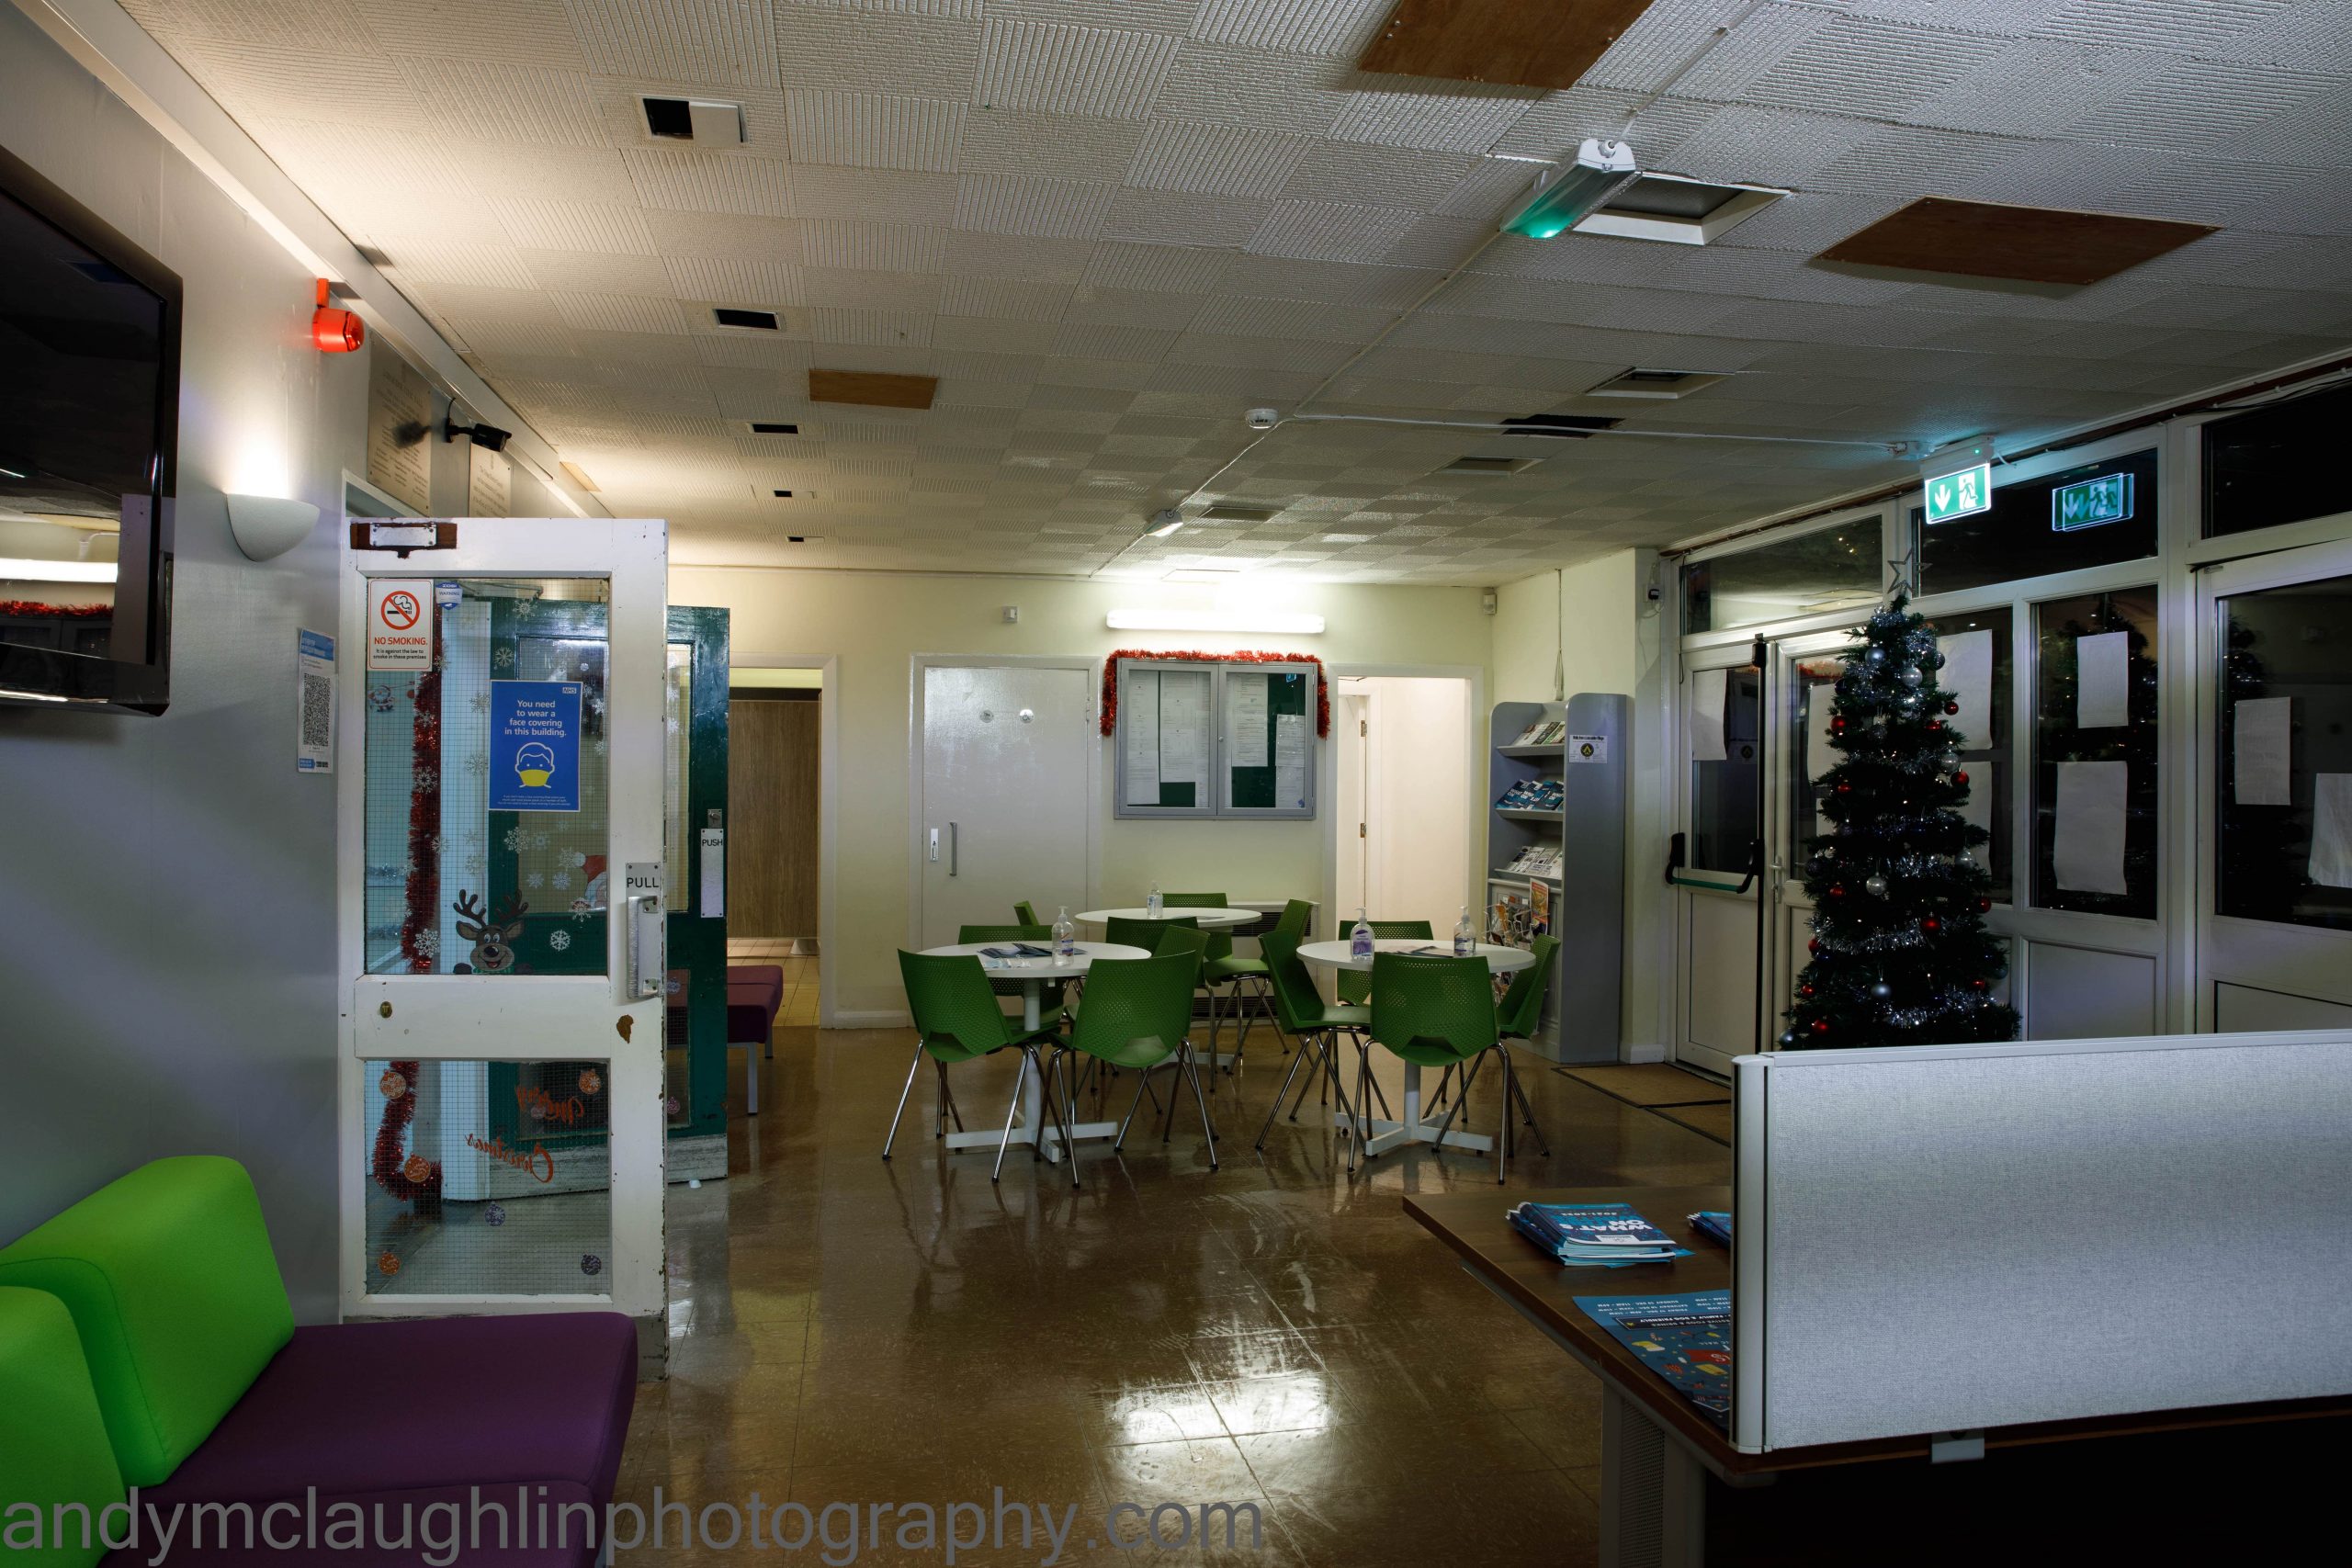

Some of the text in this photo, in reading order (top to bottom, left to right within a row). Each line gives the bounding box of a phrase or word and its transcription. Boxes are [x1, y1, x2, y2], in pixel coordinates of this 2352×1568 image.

[374, 637, 428, 645] NO SMOKING.
[517, 700, 556, 708] You need
[510, 717, 562, 728] face covering
[532, 728, 567, 738] building.
[702, 839, 723, 847] PUSH
[627, 876, 660, 888] PULL
[1559, 1224, 1653, 1232] WHAT'S
